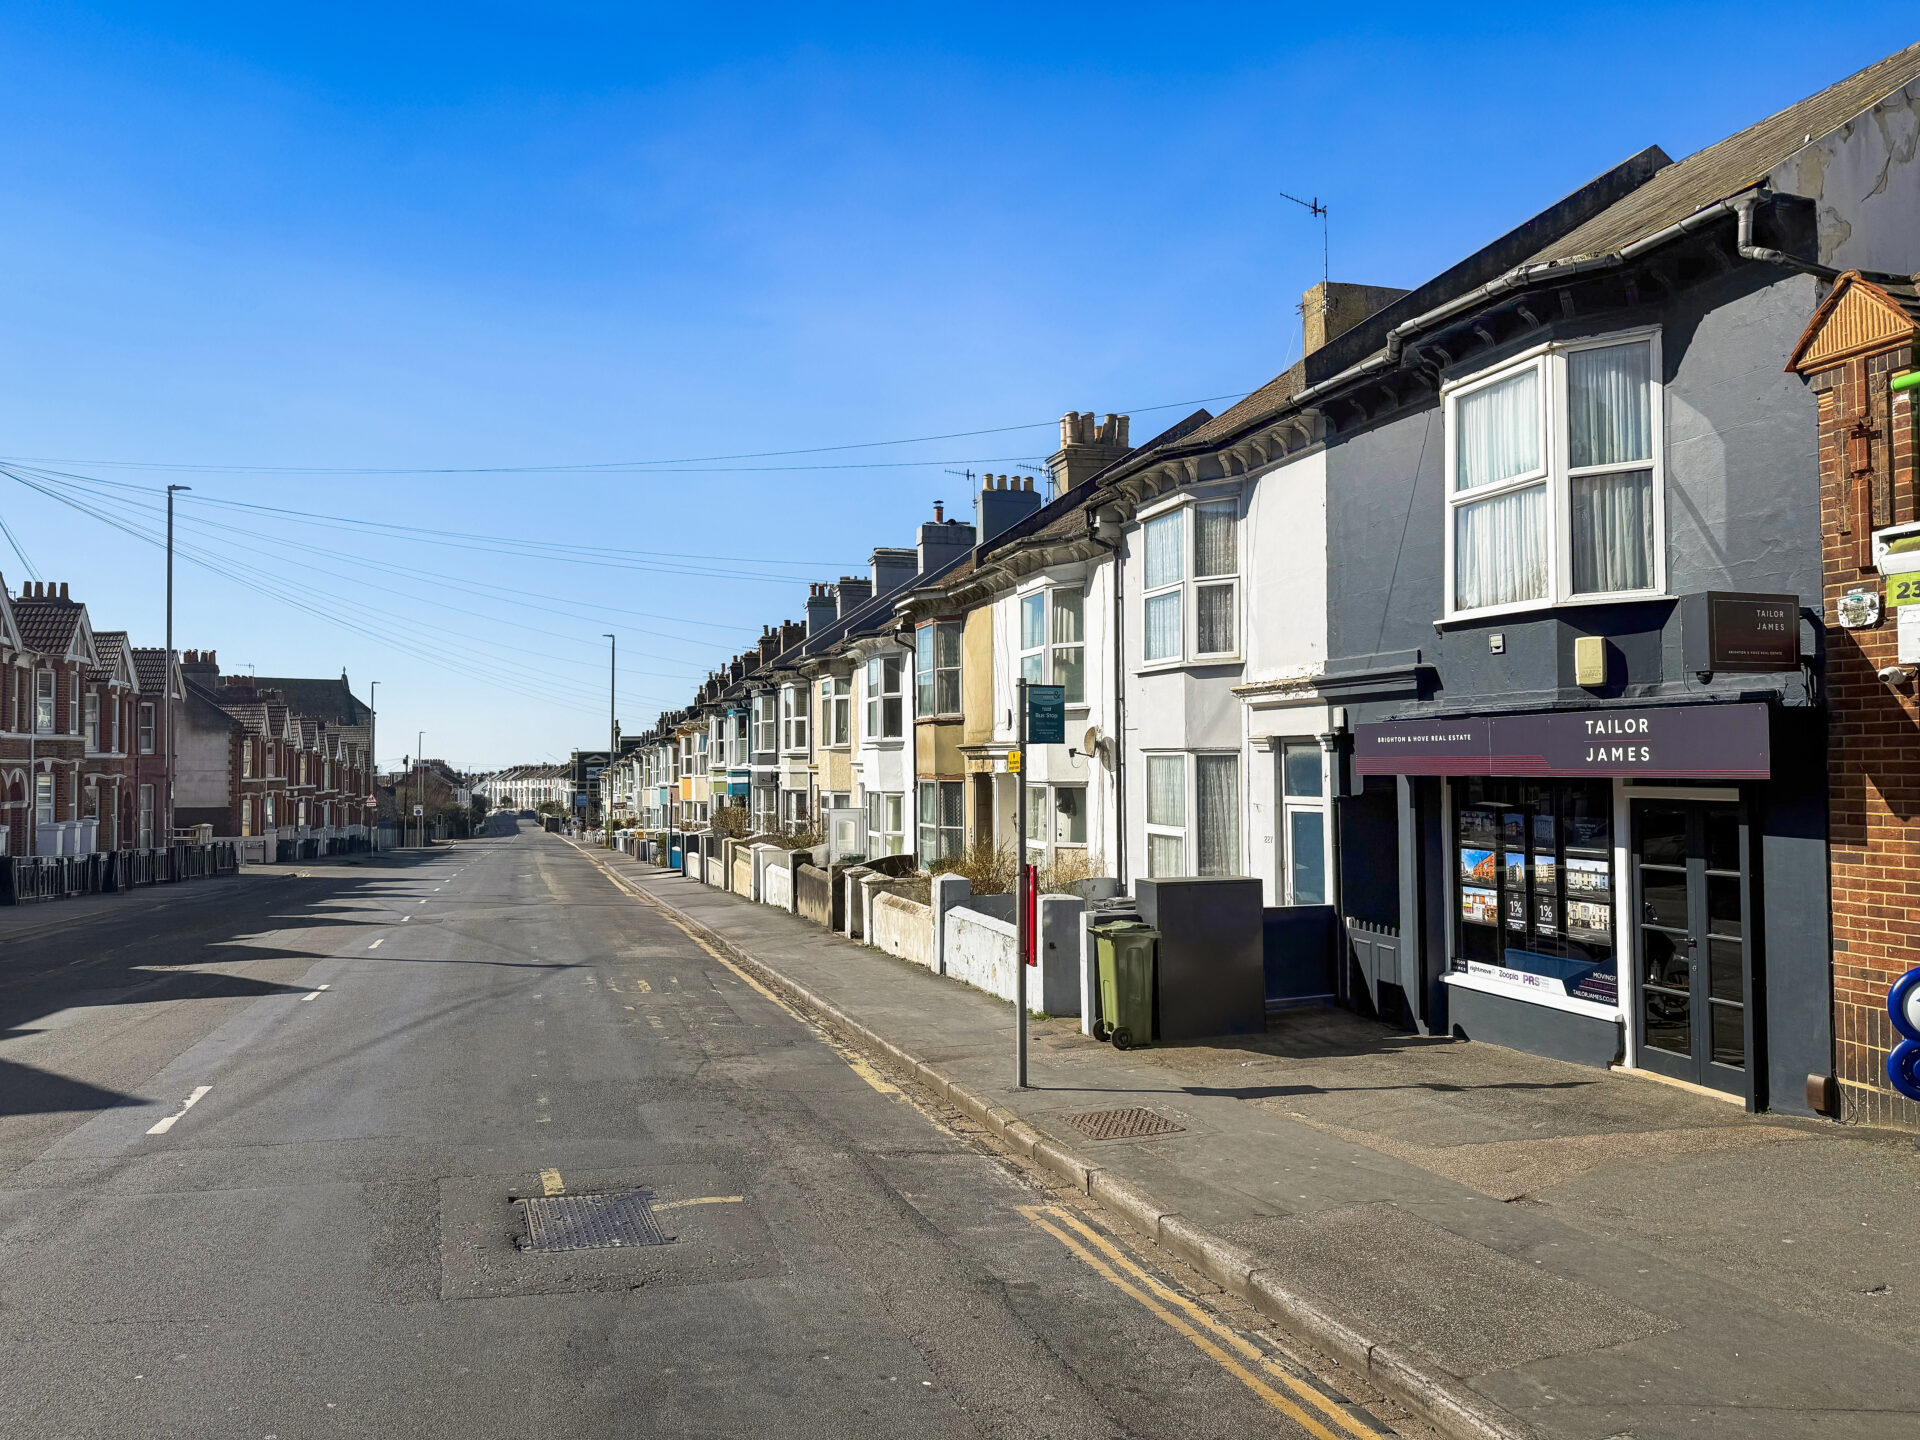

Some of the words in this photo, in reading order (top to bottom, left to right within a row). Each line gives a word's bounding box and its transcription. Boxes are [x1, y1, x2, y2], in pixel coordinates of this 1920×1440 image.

[1756, 609, 1784, 618] TAILOR
[1756, 622, 1785, 631] JAMES
[1585, 718, 1649, 735] TAILOR
[1585, 746, 1650, 762] JAMES
[1510, 900, 1522, 914] 1%
[1540, 904, 1552, 918] 1%
[1469, 964, 1492, 975] rightmove
[1498, 969, 1519, 981] Zoopla
[1522, 974, 1541, 987] PRS
[1593, 971, 1617, 982] MOVING?
